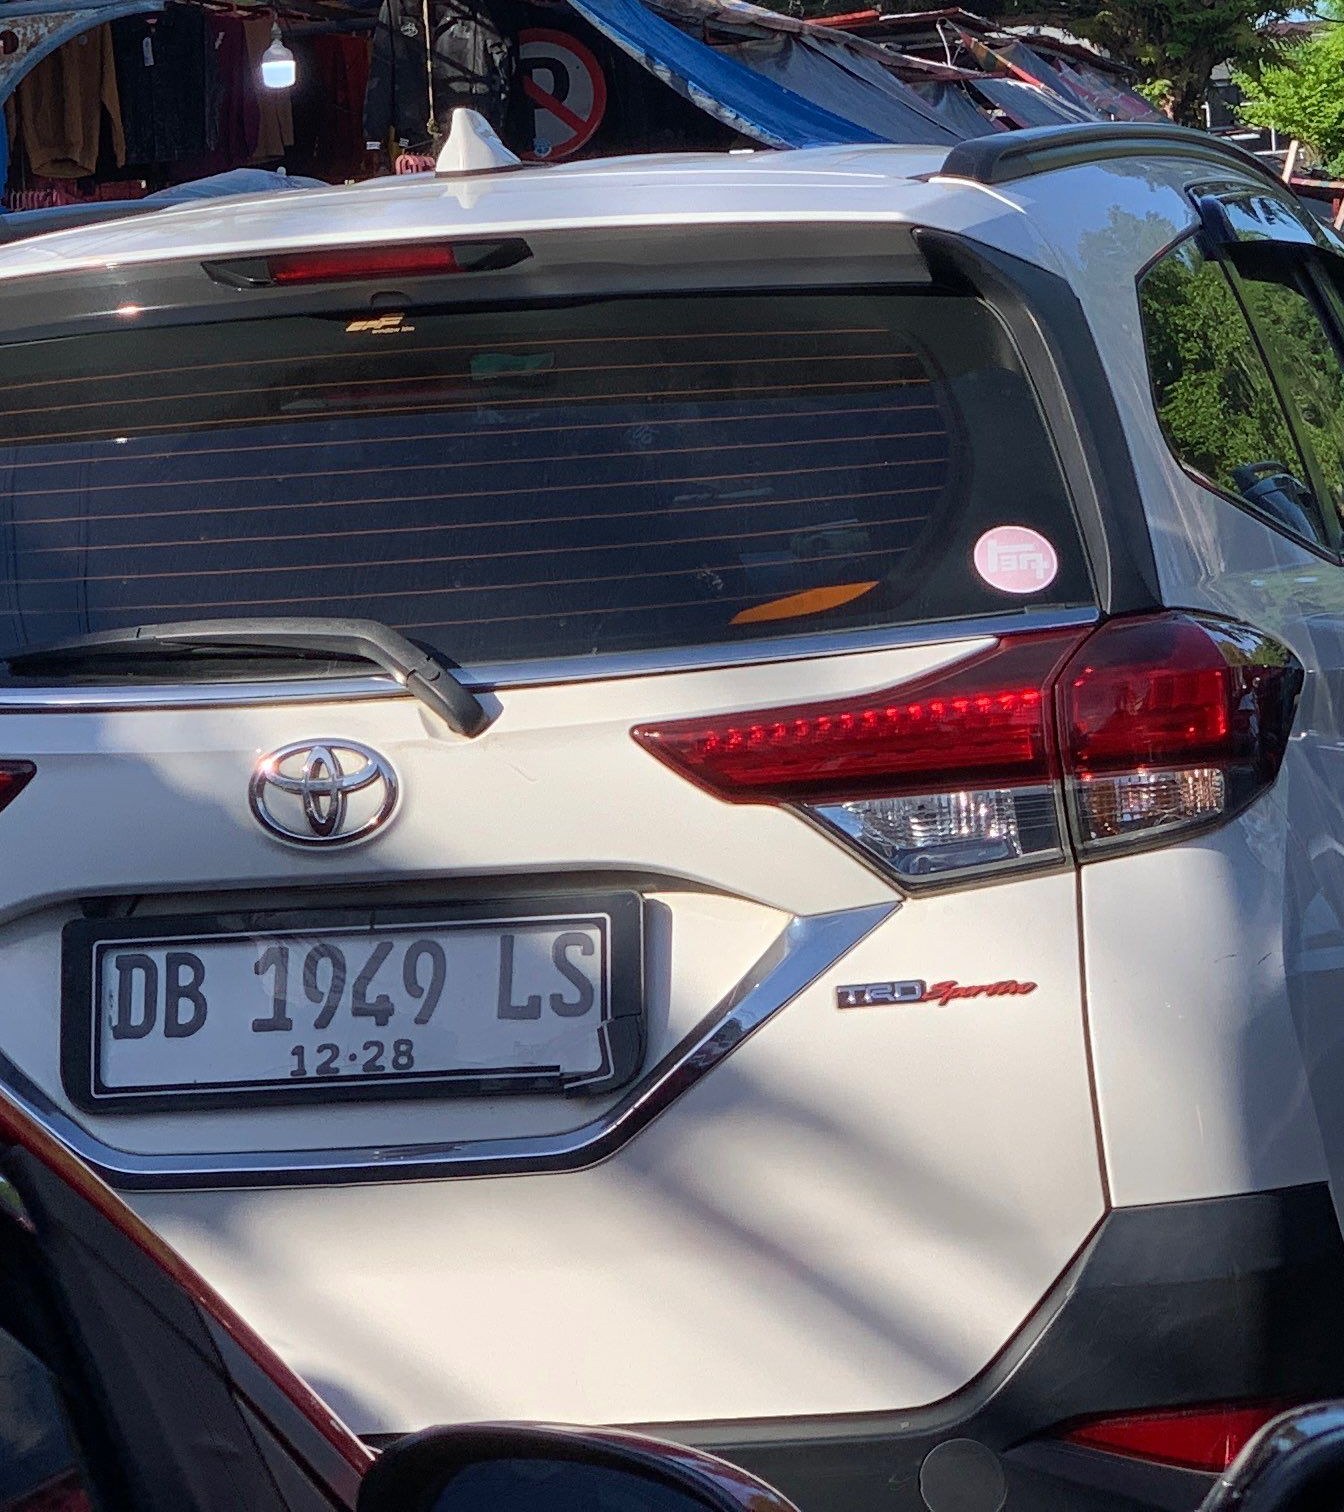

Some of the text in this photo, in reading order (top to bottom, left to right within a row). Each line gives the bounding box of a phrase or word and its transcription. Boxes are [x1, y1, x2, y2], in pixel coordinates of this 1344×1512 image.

[111, 932, 594, 1040] DB 1949 LS
[837, 980, 925, 1008] TRD
